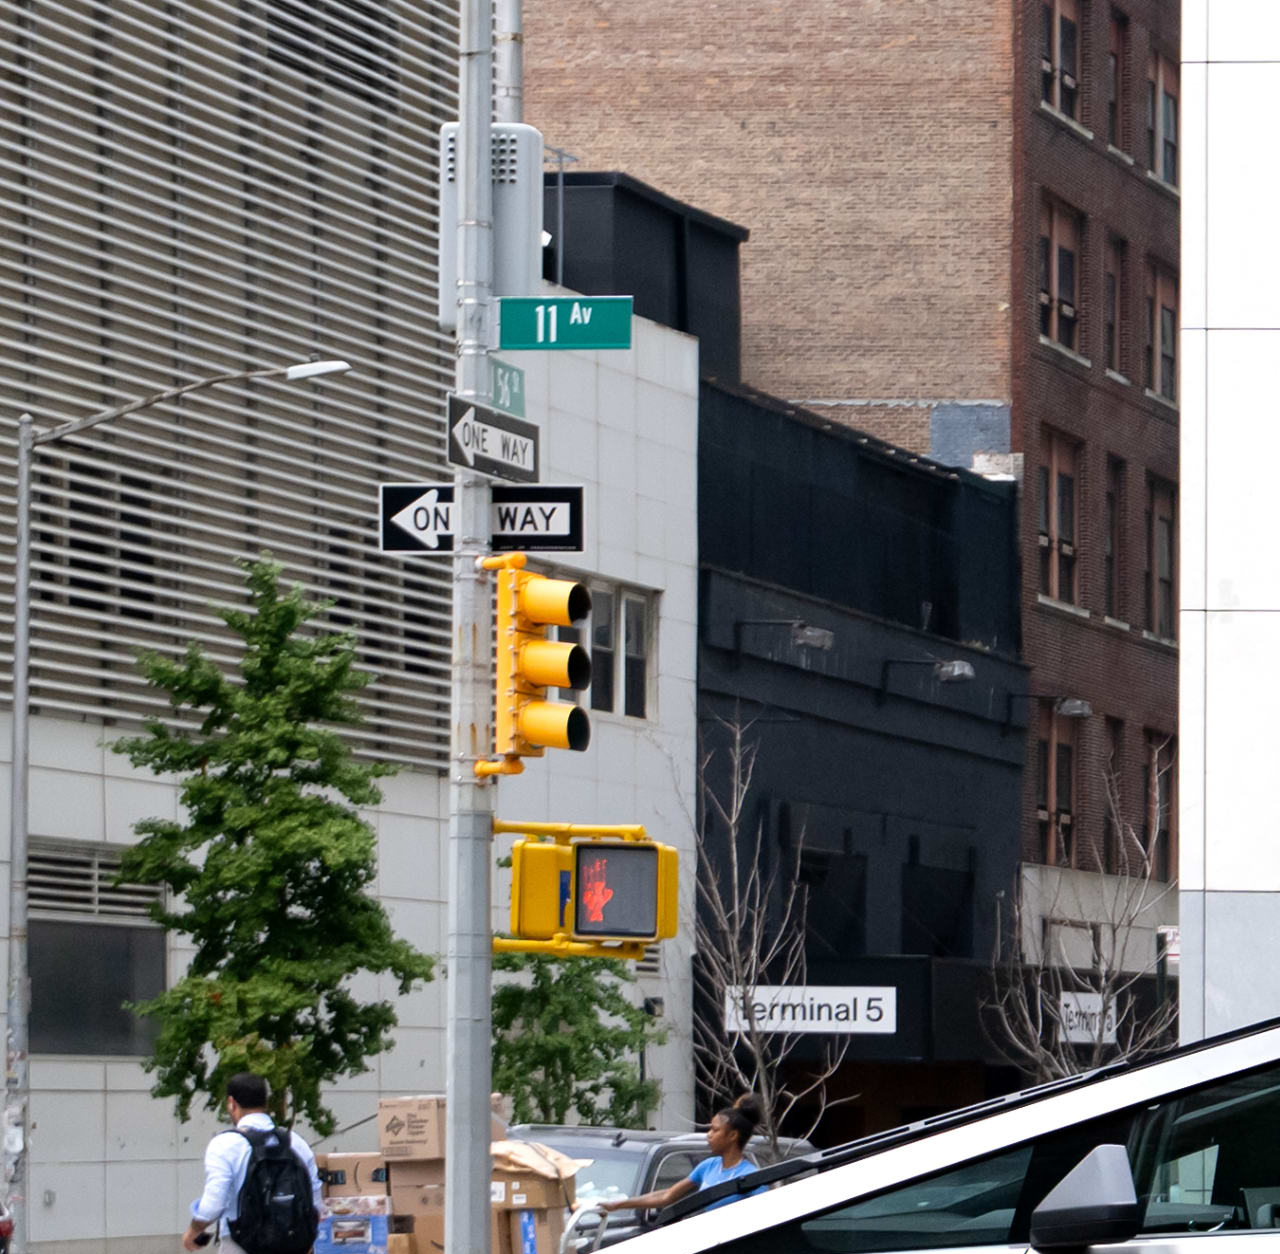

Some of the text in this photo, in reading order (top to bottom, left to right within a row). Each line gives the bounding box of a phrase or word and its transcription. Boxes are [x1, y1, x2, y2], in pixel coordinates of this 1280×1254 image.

[535, 302, 592, 343] 11 Av
[462, 422, 528, 465] ONE WAY
[413, 506, 557, 531] ON WAY
[866, 997, 883, 1022] 5
[1063, 1003, 1103, 1031] Termin
